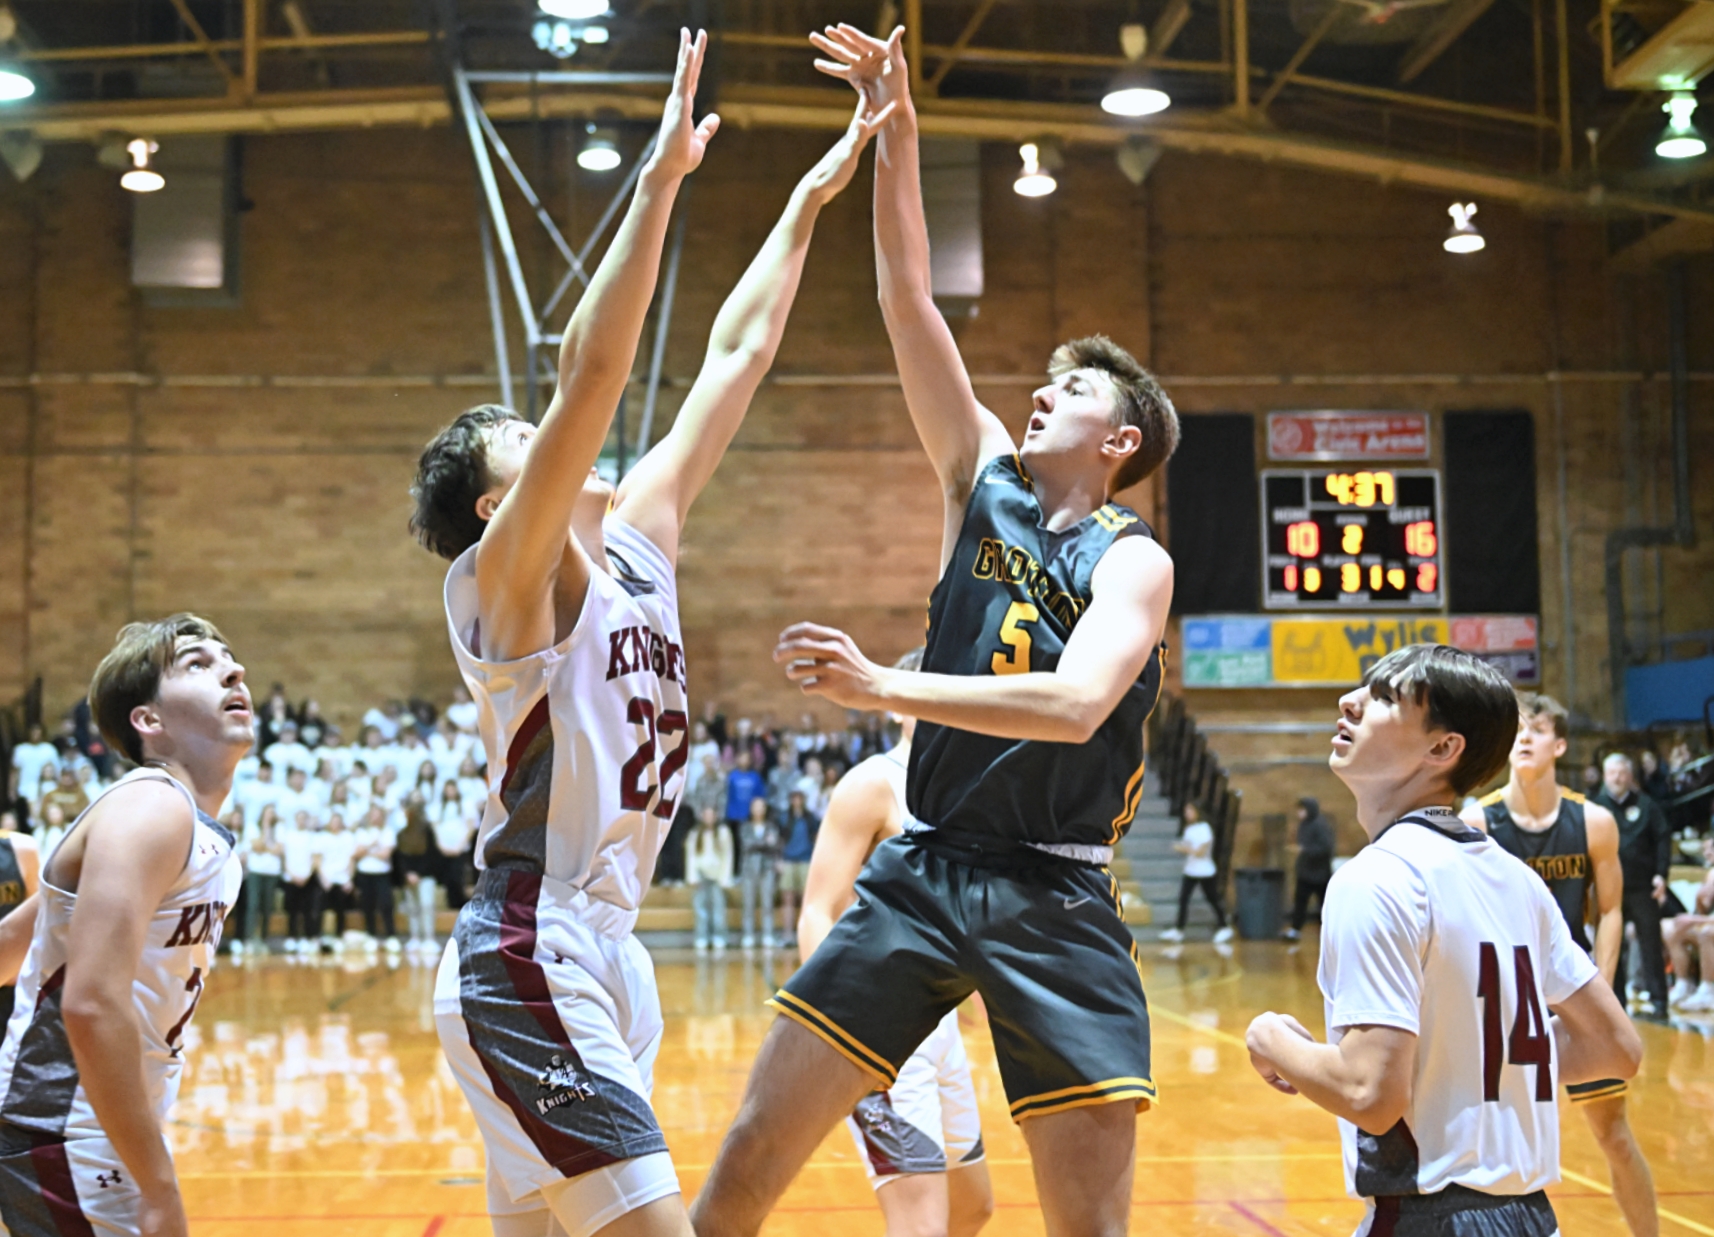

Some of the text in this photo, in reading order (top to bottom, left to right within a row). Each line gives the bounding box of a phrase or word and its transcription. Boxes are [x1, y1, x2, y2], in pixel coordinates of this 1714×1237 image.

[1325, 470, 1395, 507] 4:37
[1287, 521, 1320, 558] 10
[1405, 520, 1437, 557] 16
[991, 600, 1040, 676] 5
[620, 696, 689, 820] 22
[1425, 809, 1448, 817] NIKE
[1477, 940, 1553, 1102] 14
